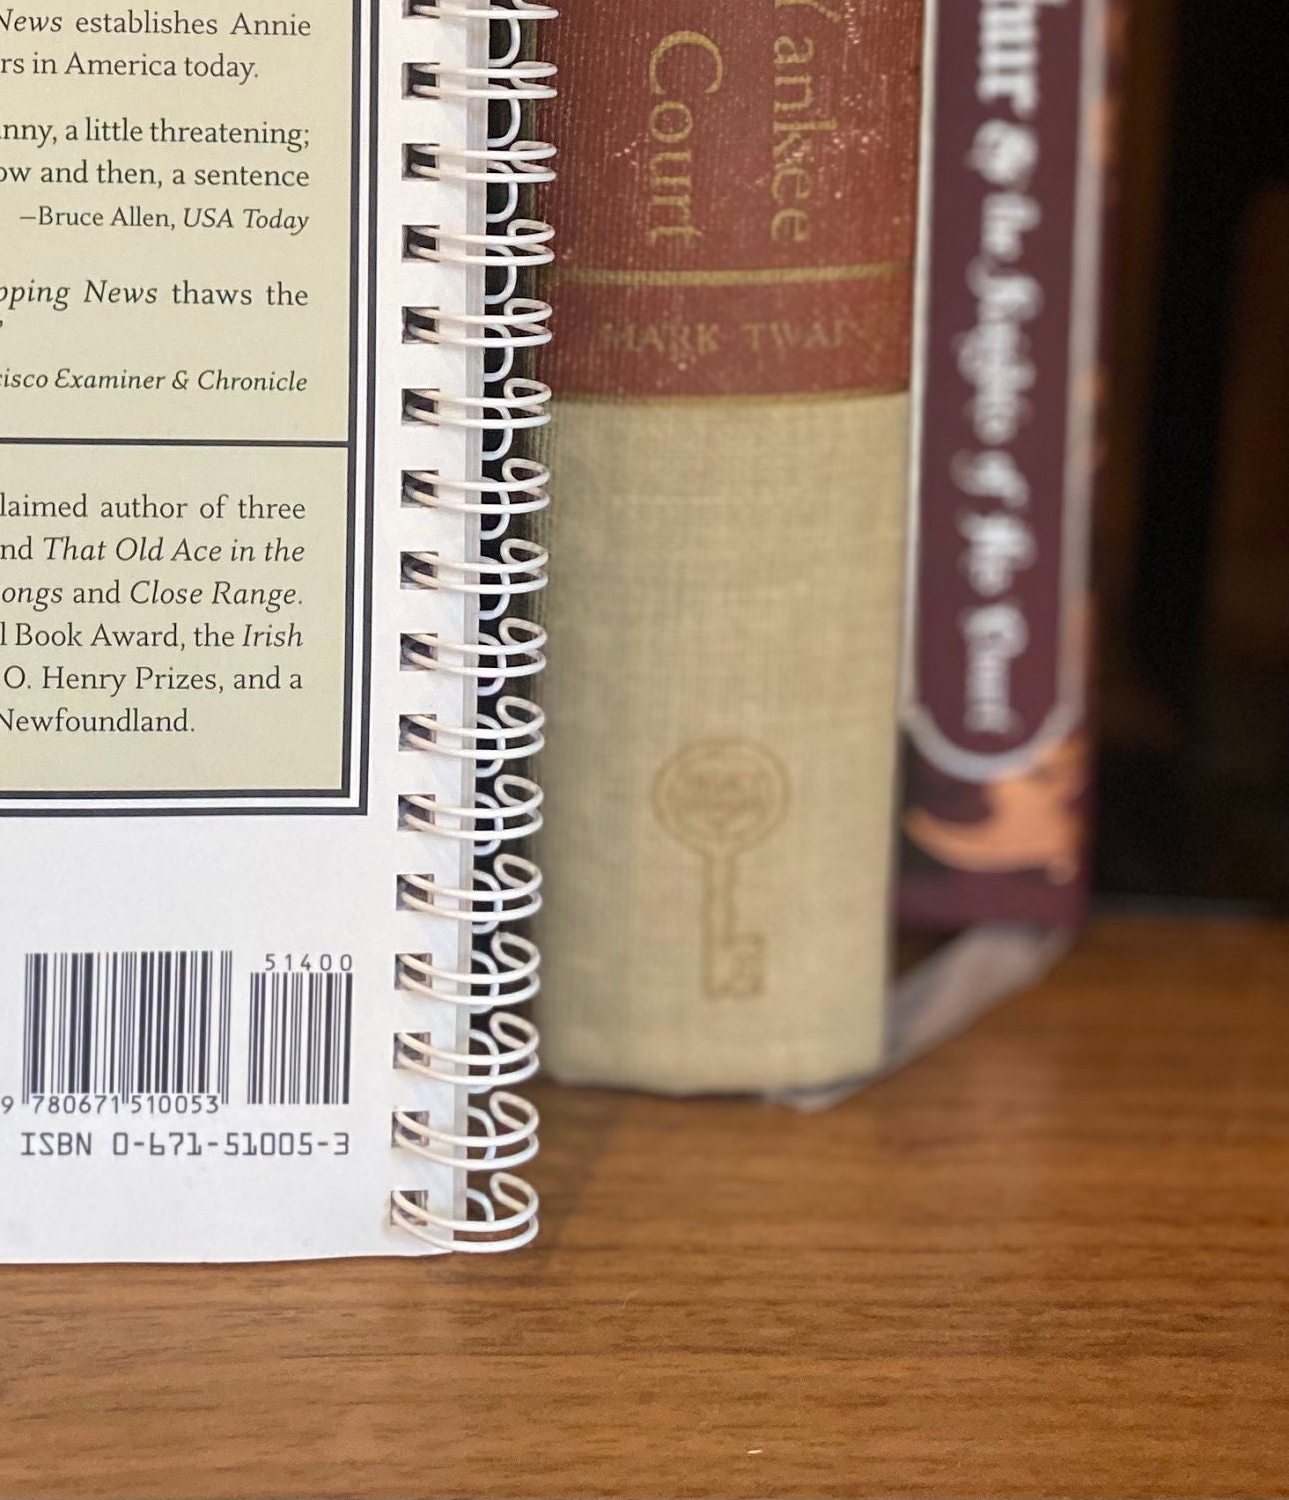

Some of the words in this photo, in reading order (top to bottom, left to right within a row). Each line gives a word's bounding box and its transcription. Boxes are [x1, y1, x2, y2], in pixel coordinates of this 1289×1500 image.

[74, 8, 219, 36] establishes
[228, 11, 312, 38] Annie
[647, 29, 723, 247] Court
[108, 204, 177, 232] Allen,
[183, 206, 235, 229] USA
[242, 206, 311, 237] Today
[599, 320, 720, 356] MARK
[54, 366, 167, 391] Examiner
[170, 368, 191, 392] &
[197, 367, 309, 393] Chronicle
[99, 492, 190, 520] author
[198, 492, 230, 520] of
[236, 492, 307, 521] three
[71, 577, 122, 605] and
[129, 578, 204, 606] Close
[210, 580, 304, 614] Range.
[264, 953, 353, 972] 51400
[20, 1132, 92, 1156] ISBN
[112, 1131, 350, 1156] 0-671-51005-3
